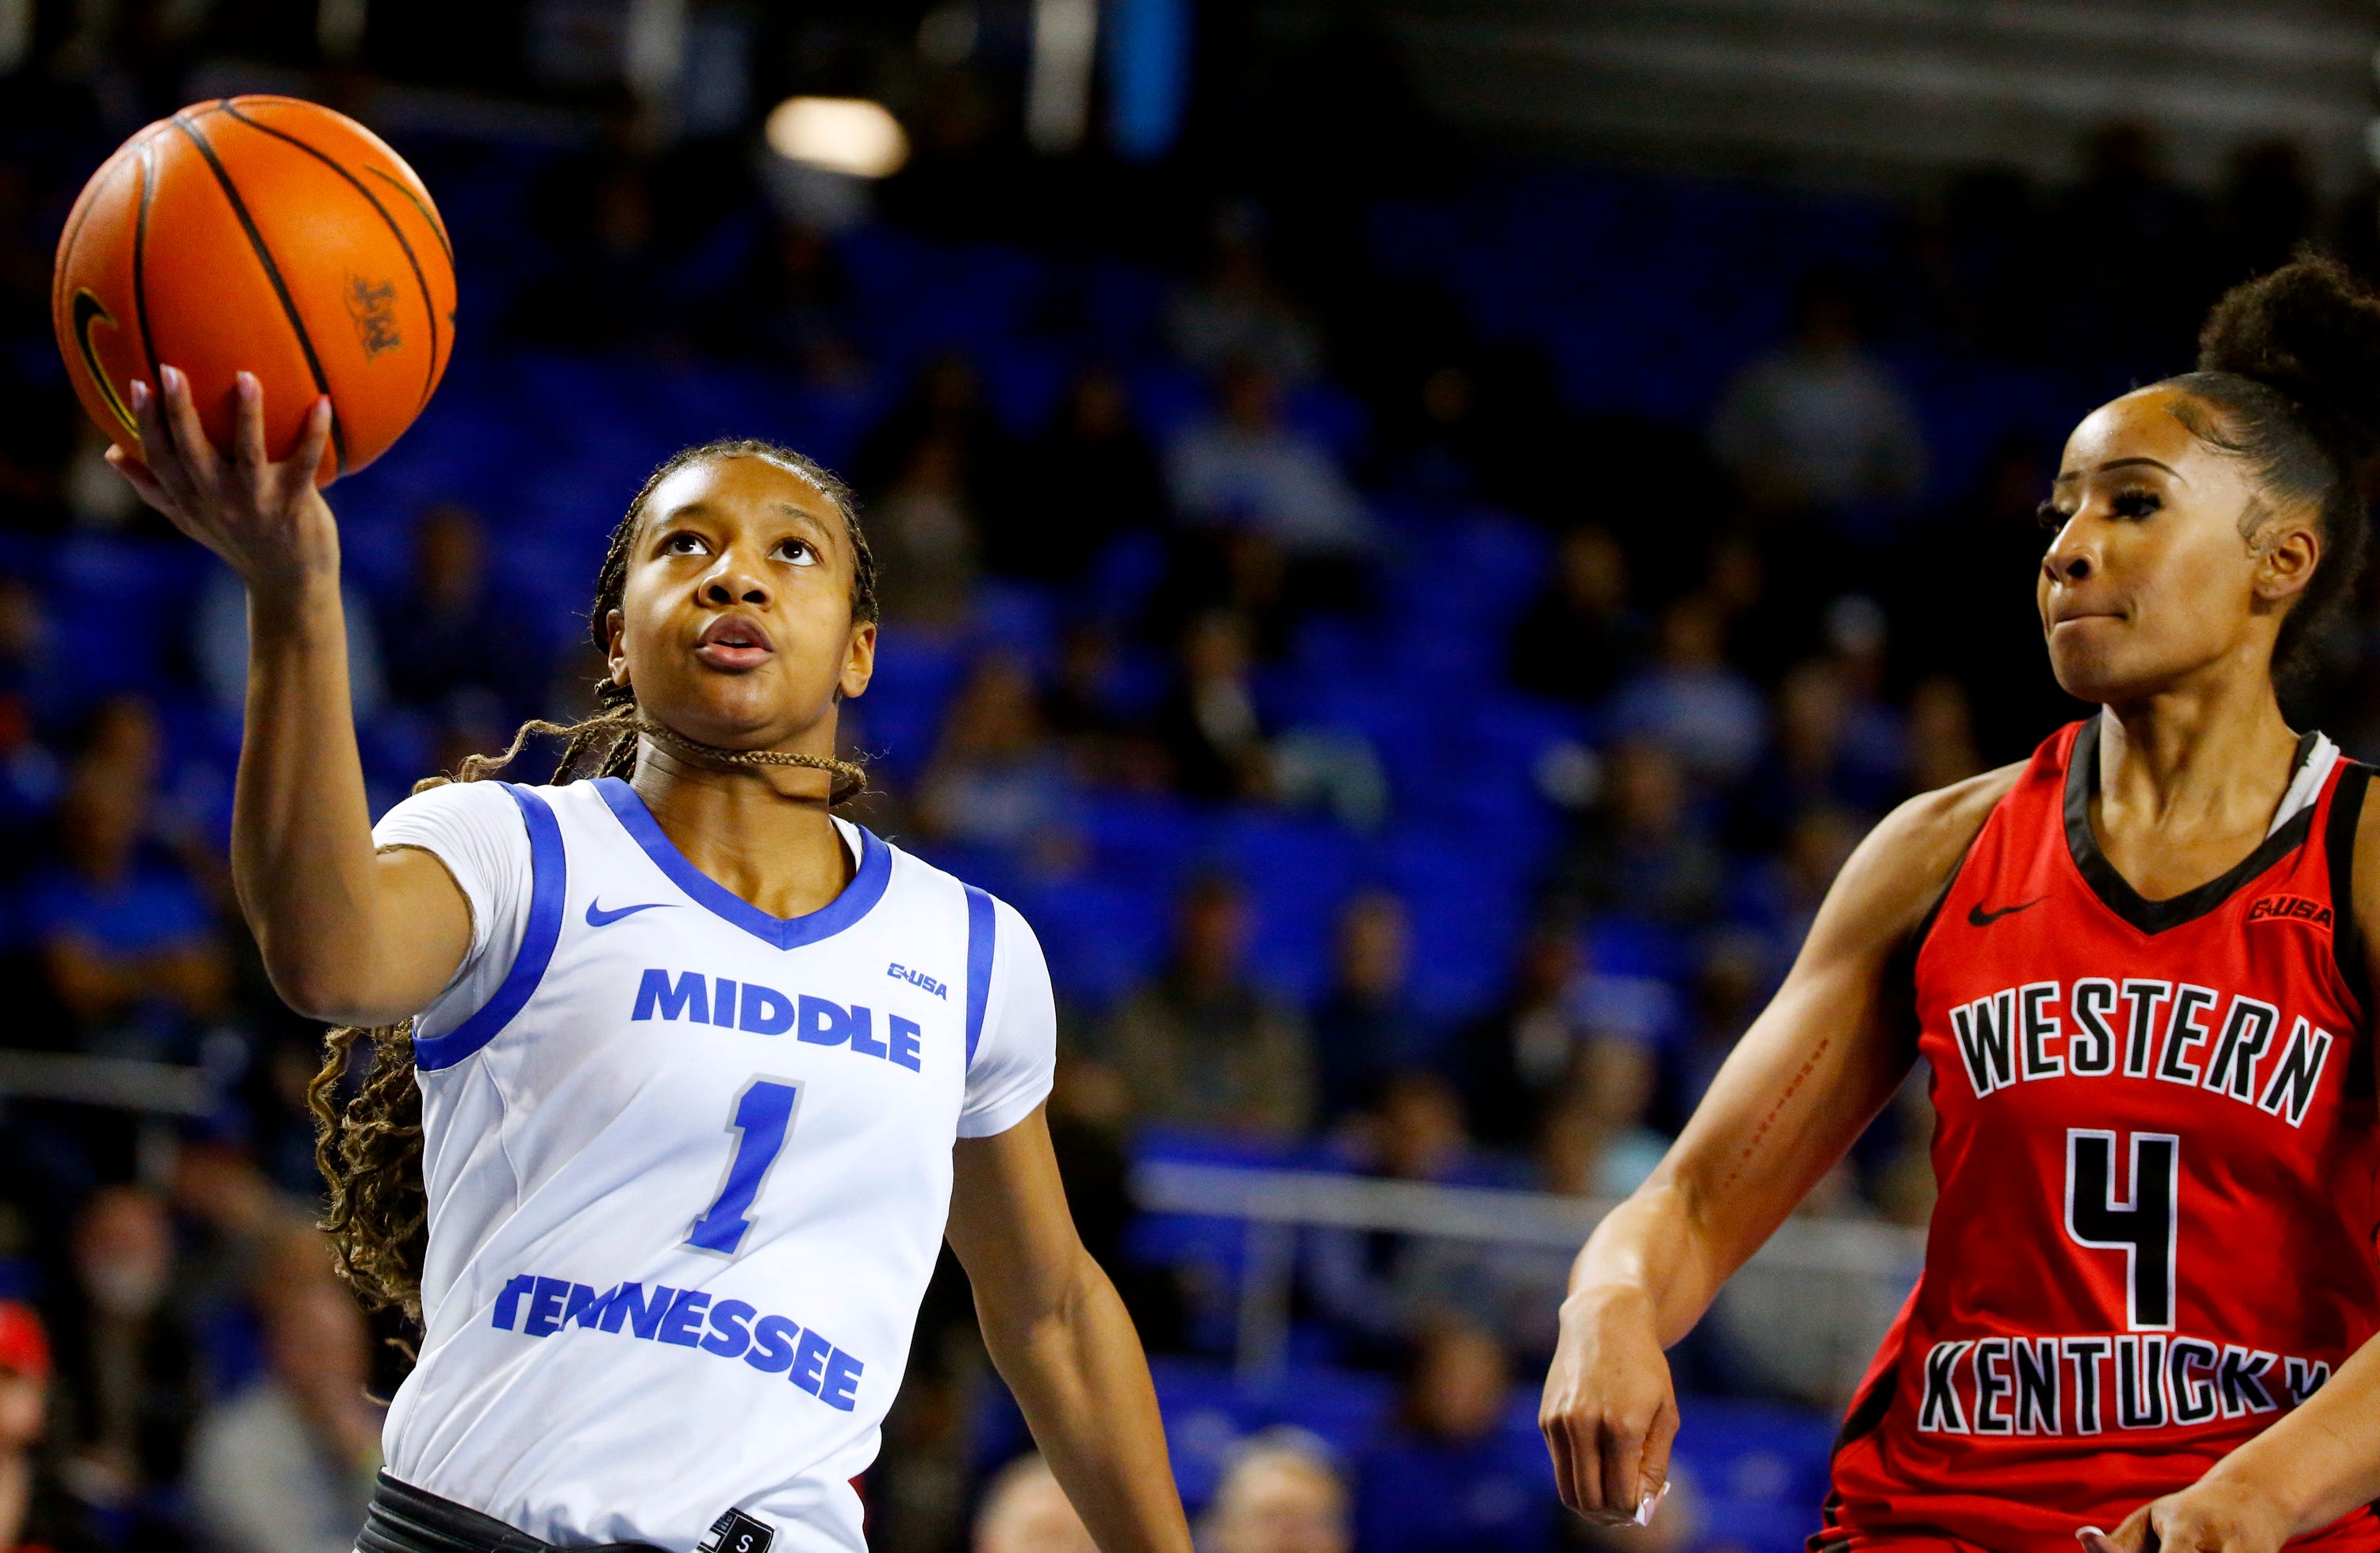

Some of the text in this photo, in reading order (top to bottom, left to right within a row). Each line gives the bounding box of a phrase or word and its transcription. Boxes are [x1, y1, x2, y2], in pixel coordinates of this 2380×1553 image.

[631, 968, 921, 1074] MIDDLE
[1948, 977, 2333, 1128] WESTERN
[676, 1072, 806, 1262] 1
[2064, 1128, 2179, 1332] 4
[491, 1274, 865, 1413] TENNESSEE
